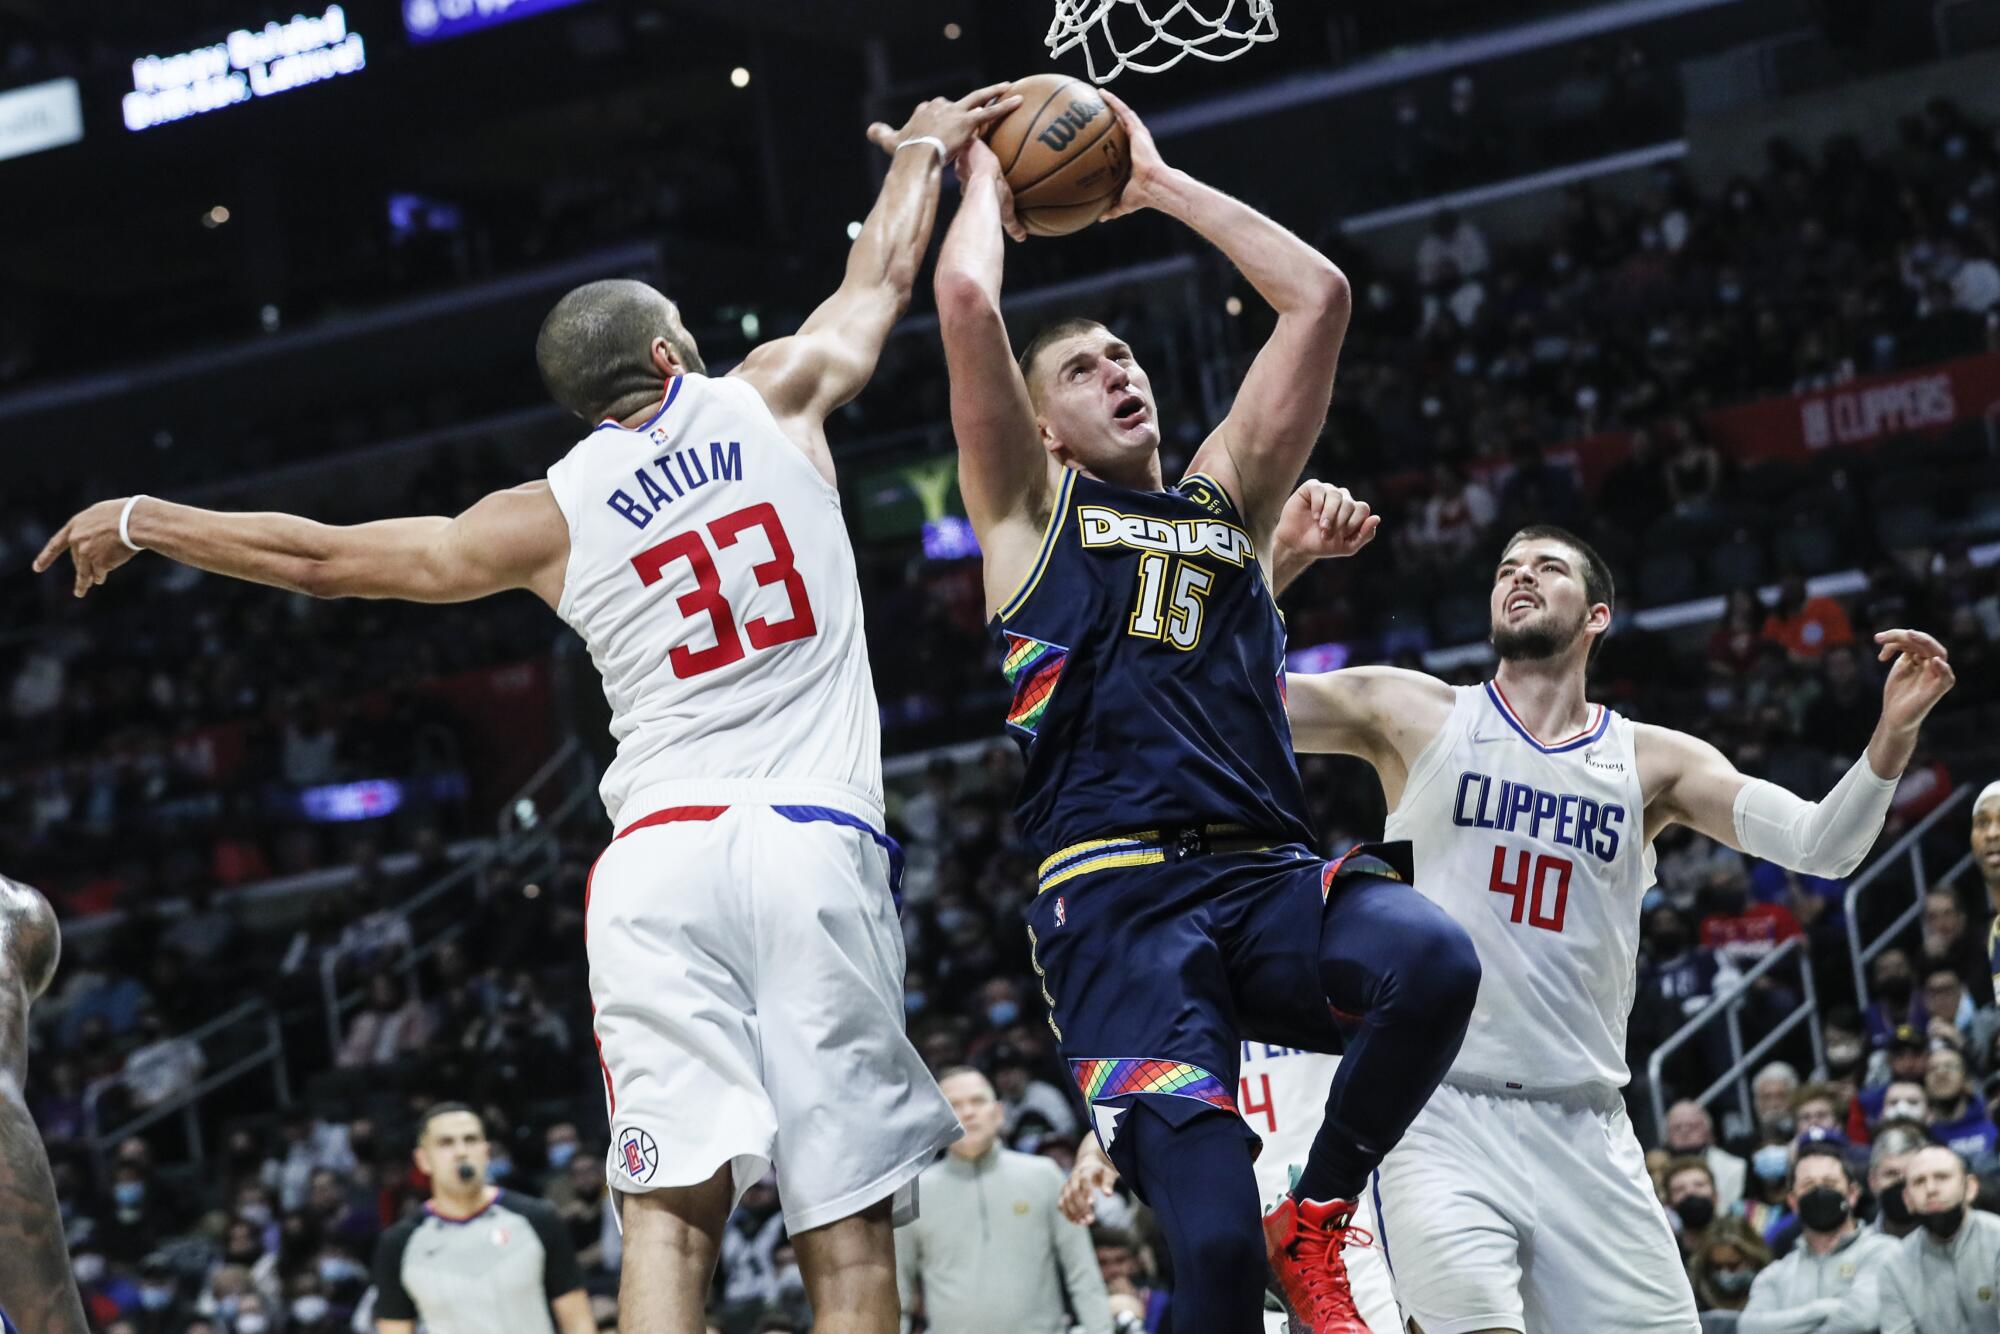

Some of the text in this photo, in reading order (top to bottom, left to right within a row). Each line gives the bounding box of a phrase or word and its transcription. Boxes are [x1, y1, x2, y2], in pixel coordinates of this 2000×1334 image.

[607, 441, 742, 529] BATUM
[630, 502, 818, 679] 33
[1128, 551, 1215, 651] 15
[1584, 752, 1626, 772] honey
[1452, 770, 1625, 863] CLIPPERS
[1489, 845, 1573, 932] 40
